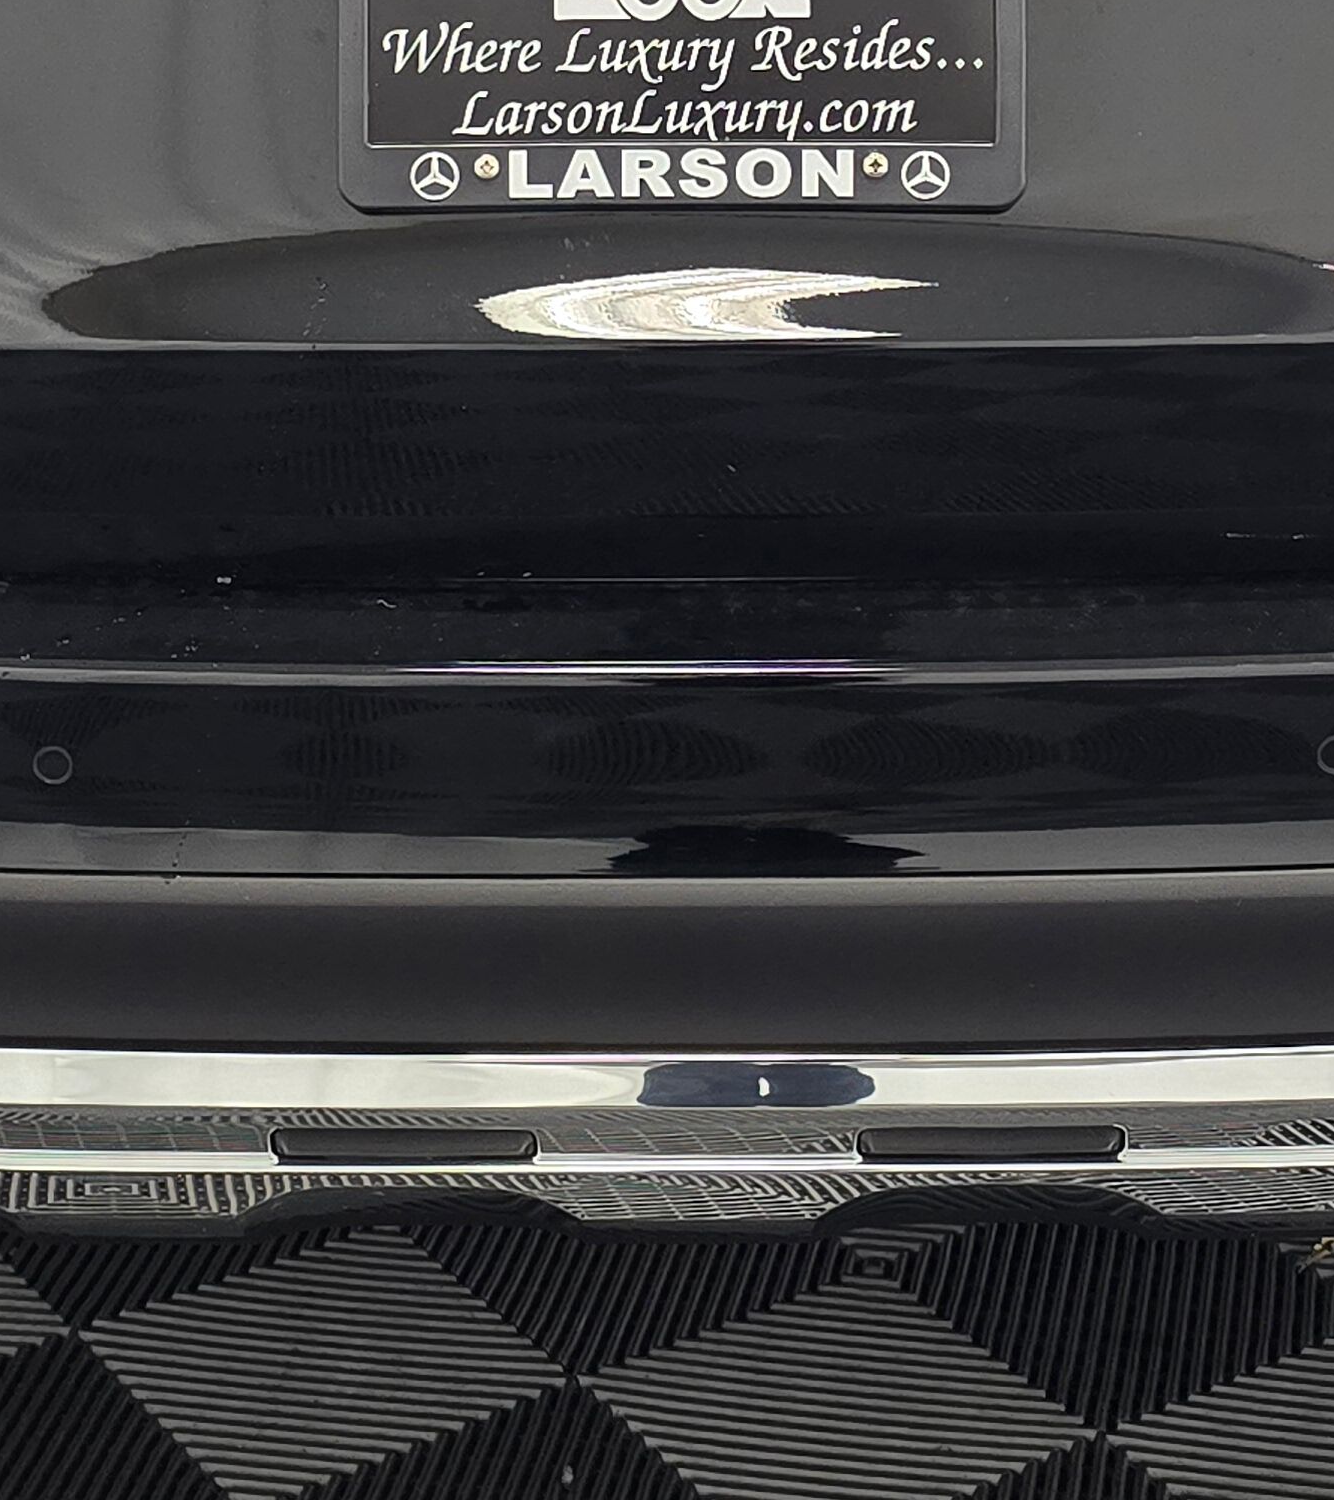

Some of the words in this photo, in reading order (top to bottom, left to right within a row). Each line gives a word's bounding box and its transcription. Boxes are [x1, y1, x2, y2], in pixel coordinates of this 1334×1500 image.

[381, 22, 542, 75] Where
[554, 26, 736, 92] Luxury
[750, 18, 985, 82] Resides...
[451, 88, 919, 142] LarsonLuxury.com
[507, 148, 856, 200] LARSON
